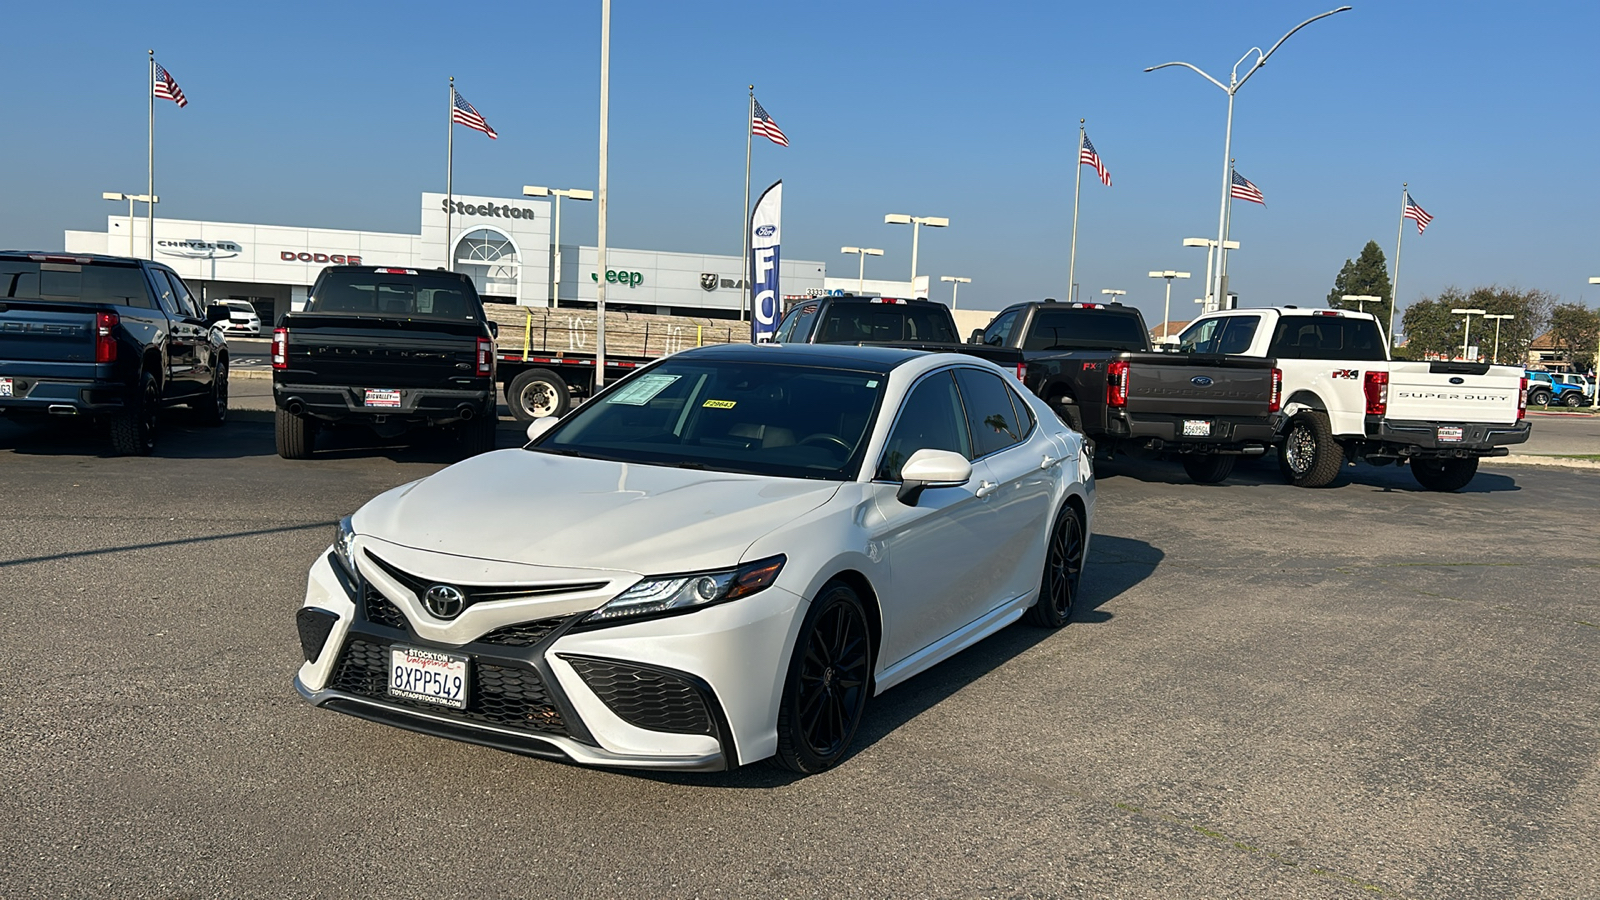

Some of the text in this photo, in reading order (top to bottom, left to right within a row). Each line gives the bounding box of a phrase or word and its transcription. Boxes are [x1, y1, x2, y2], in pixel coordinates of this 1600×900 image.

[442, 199, 534, 219] Stockton
[157, 240, 236, 251] CHRYSLER
[281, 251, 362, 266] DODGE
[720, 279, 750, 289] RA
[806, 288, 823, 297] 3333
[1332, 369, 1359, 380] FX4
[1212, 389, 1264, 398] DUTY
[1399, 392, 1459, 400] SUPER
[408, 649, 448, 662] STOCKTON
[395, 666, 461, 698] 8XPP549
[391, 689, 461, 707] TOYOTAOFSTOCKTON.COM
